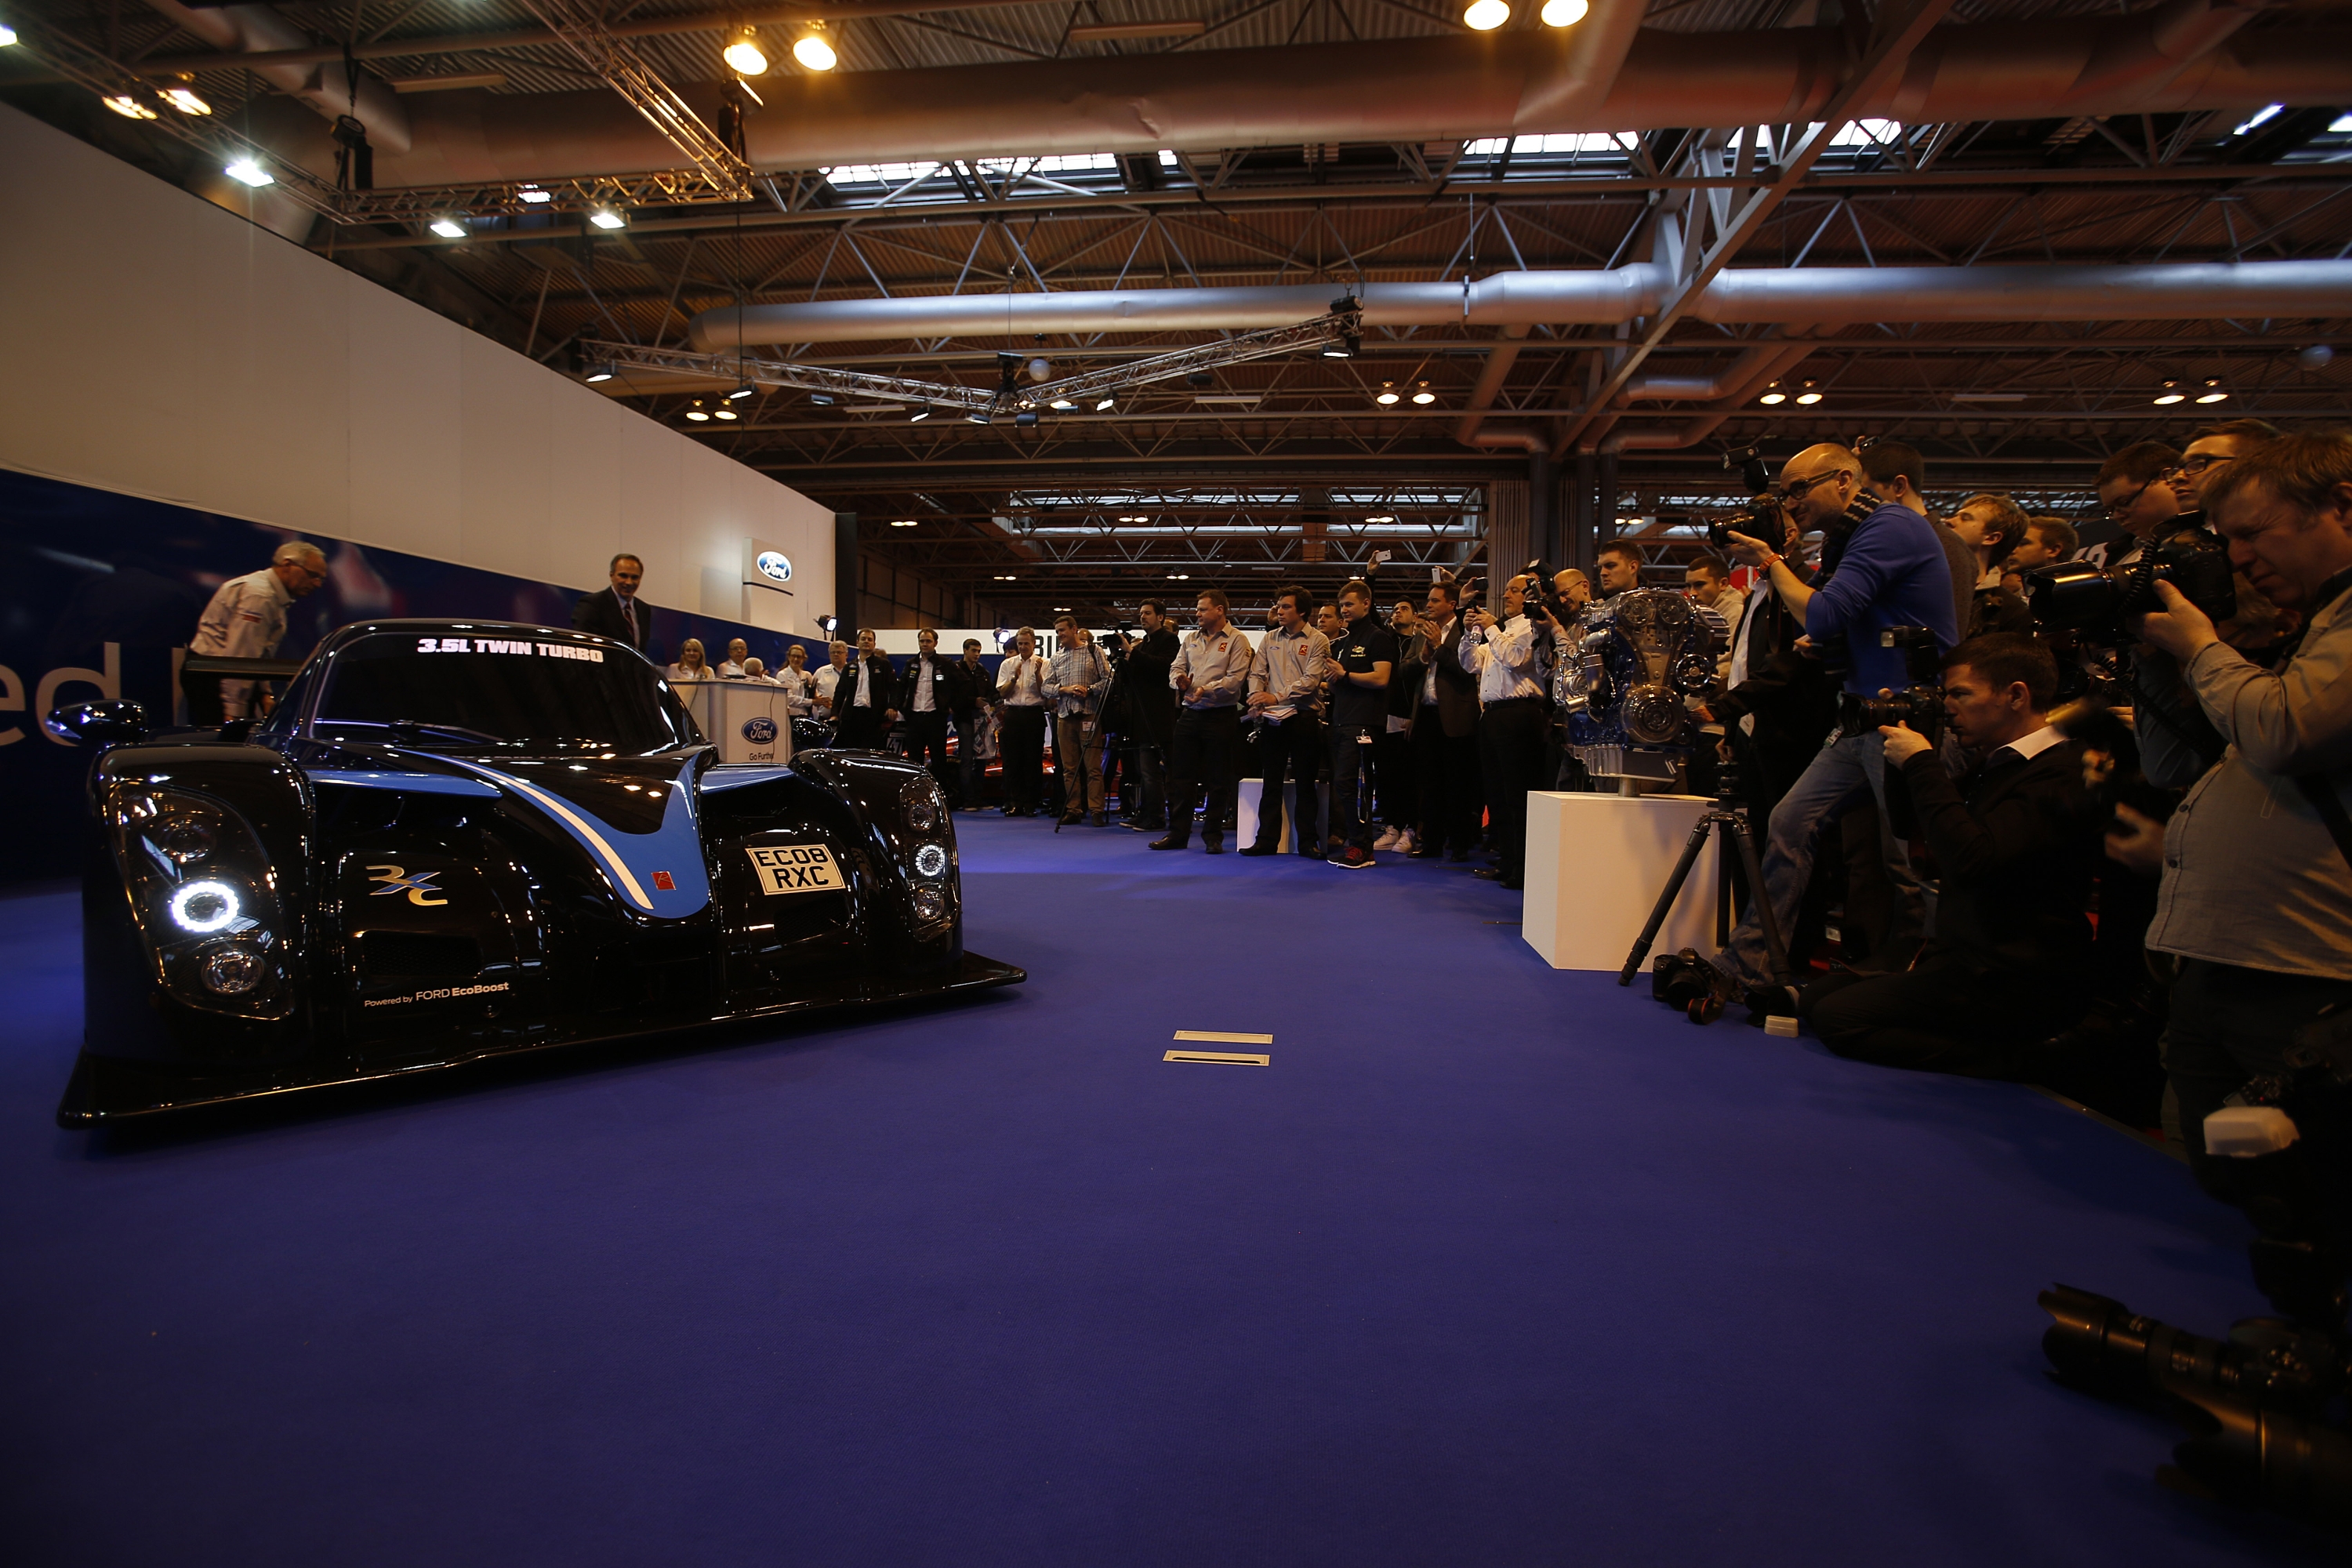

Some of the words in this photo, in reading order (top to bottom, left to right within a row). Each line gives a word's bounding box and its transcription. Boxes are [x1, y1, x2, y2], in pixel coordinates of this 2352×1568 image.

[417, 638, 471, 653] 3.5L
[474, 639, 532, 655] TWIN
[535, 643, 604, 663] TURBO
[753, 848, 829, 867] EC08
[772, 866, 829, 889] RXC
[364, 996, 401, 1007] Powered
[402, 995, 414, 1004] by
[416, 989, 451, 1001] FORD
[452, 982, 510, 996] EcoBoost
